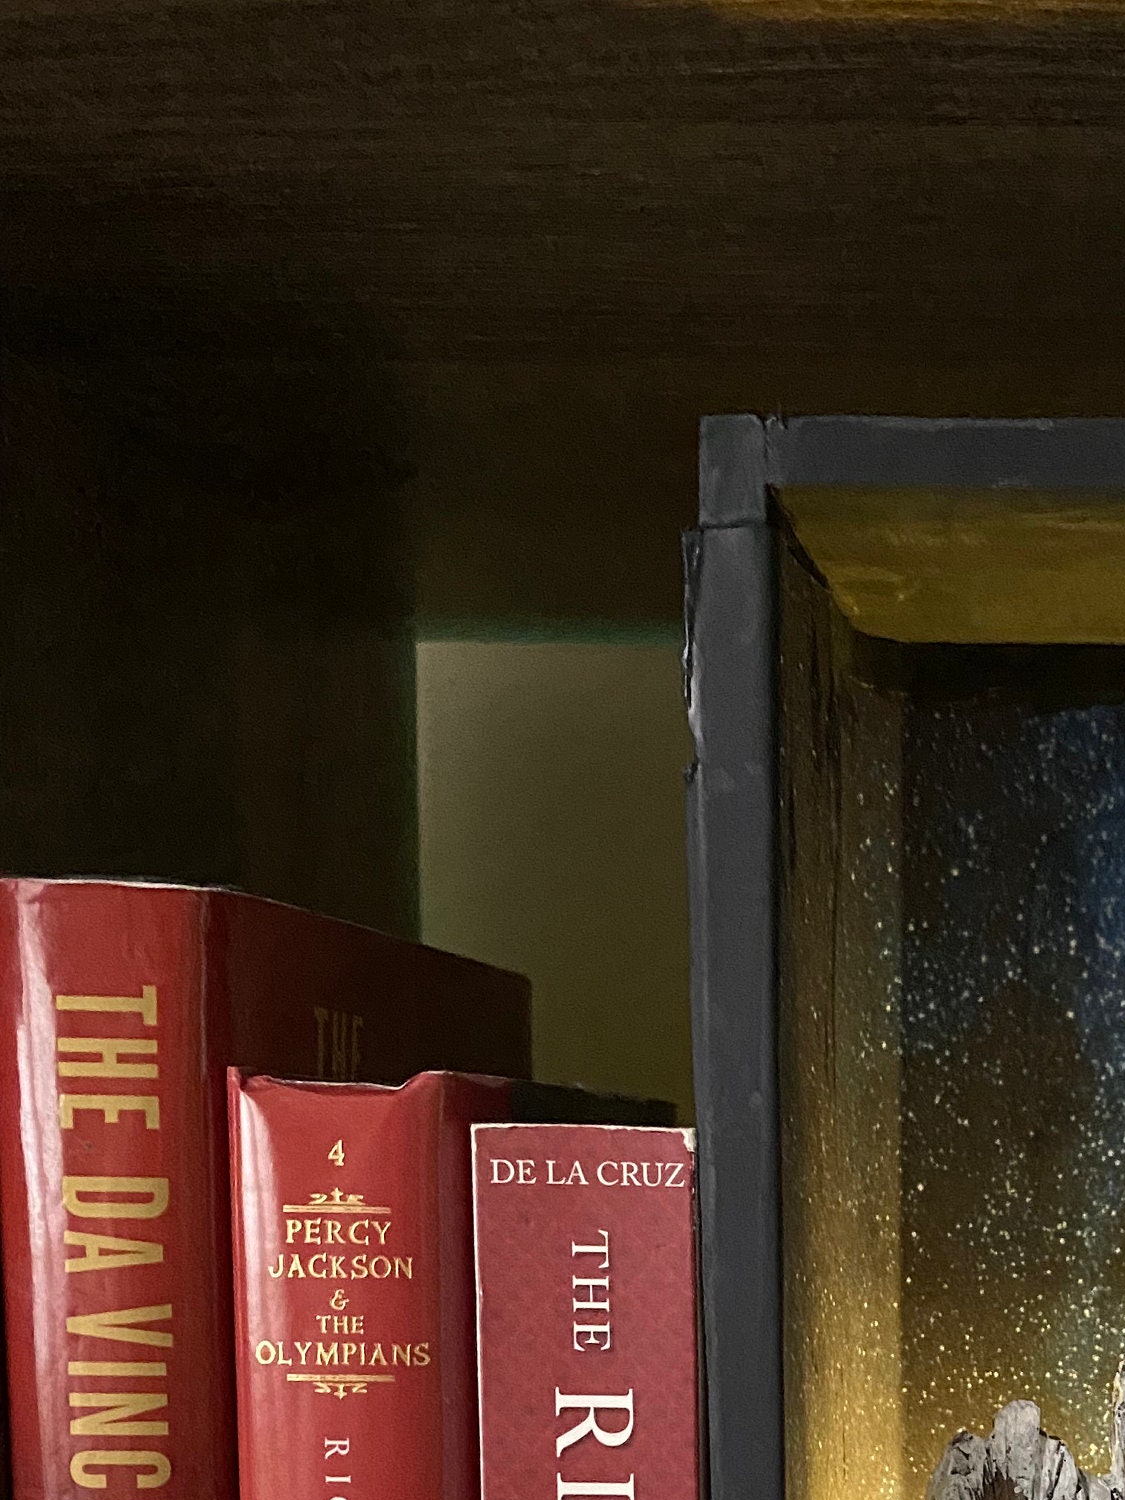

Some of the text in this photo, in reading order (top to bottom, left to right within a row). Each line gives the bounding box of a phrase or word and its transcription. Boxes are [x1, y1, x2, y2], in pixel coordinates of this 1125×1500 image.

[56, 985, 160, 1130] THE
[327, 1140, 346, 1167] 4
[490, 1159, 685, 1188] DE LA CRUZ
[62, 1176, 170, 1273] DA
[285, 1219, 392, 1245] PERCY
[268, 1254, 414, 1280] JACKSON
[330, 1289, 350, 1310] &
[571, 1229, 612, 1352] THE
[316, 1315, 365, 1334] THE
[255, 1340, 432, 1367] OLYMPIANS
